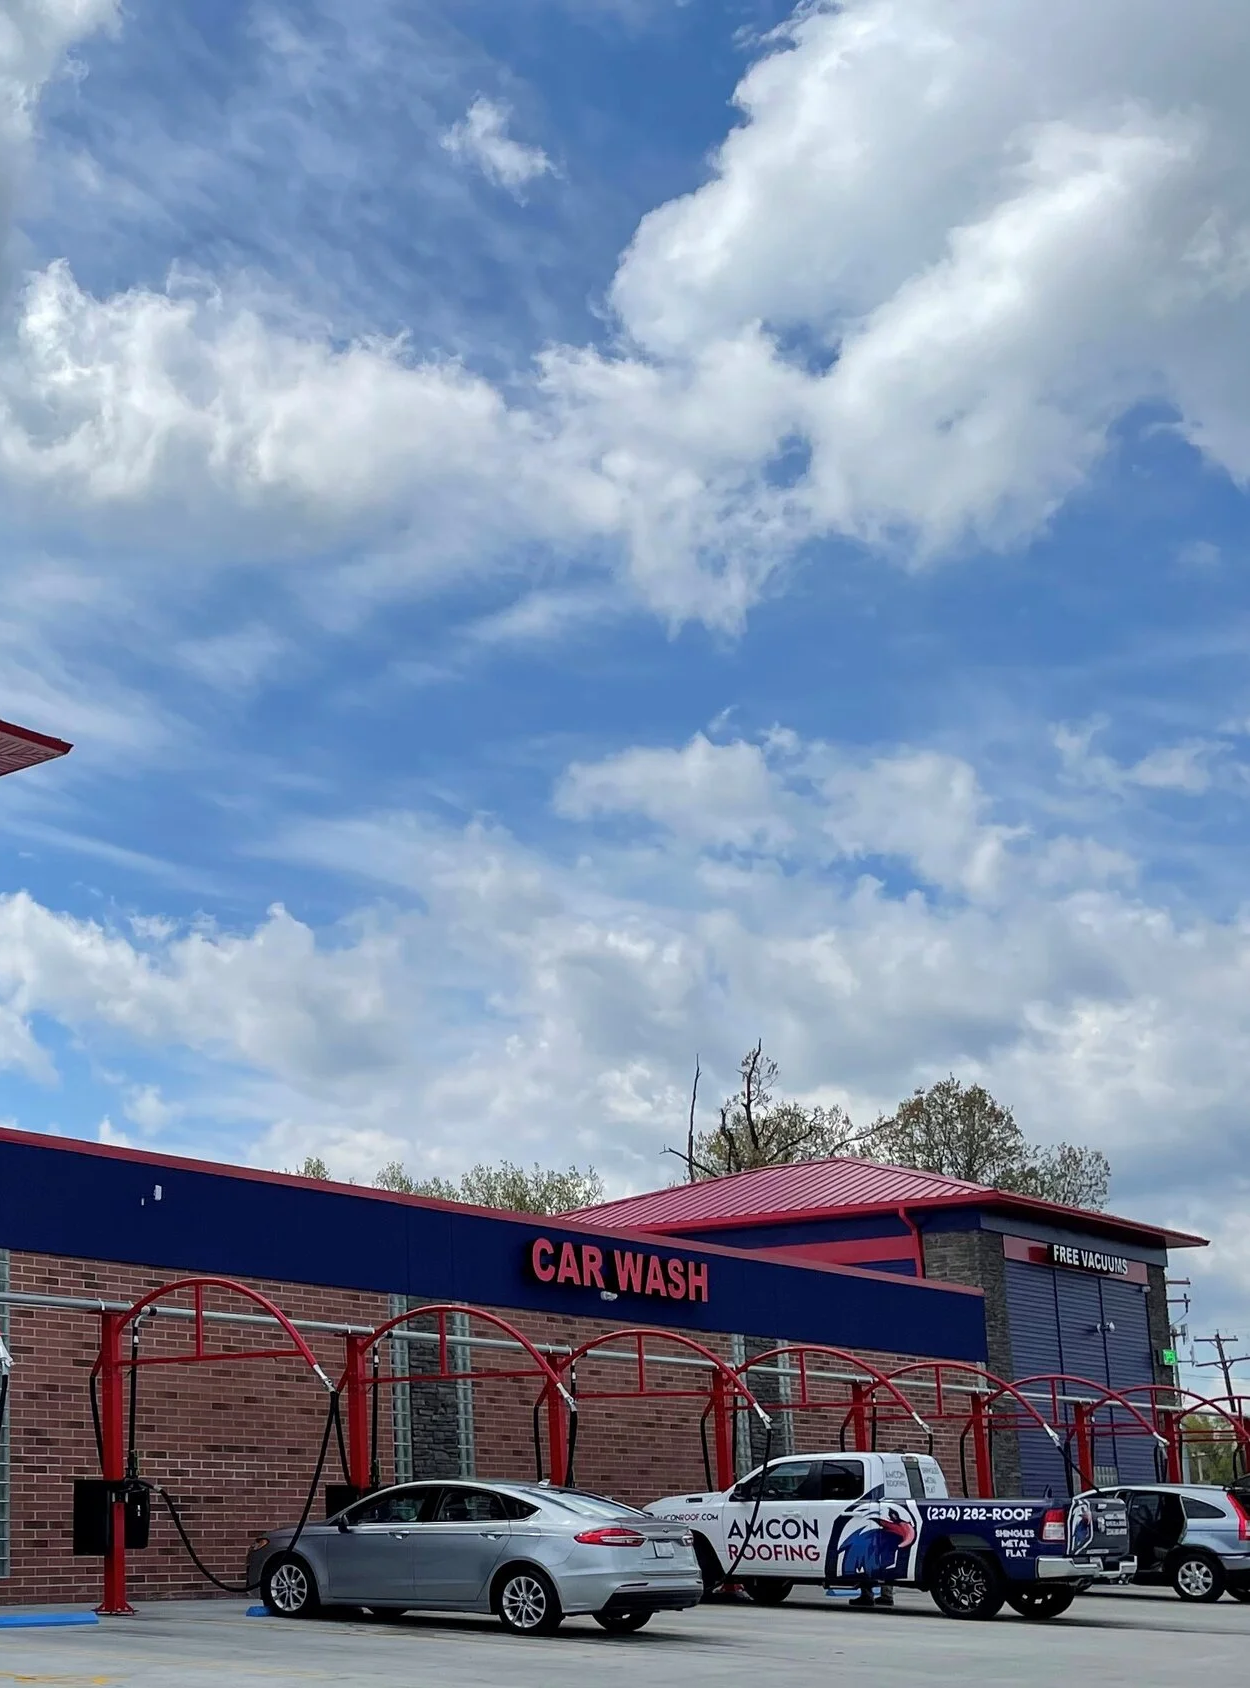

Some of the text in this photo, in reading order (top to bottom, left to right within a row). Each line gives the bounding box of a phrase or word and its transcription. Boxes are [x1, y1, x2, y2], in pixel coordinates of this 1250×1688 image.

[1053, 1244, 1129, 1275] FREE VACUUMS
[532, 1237, 709, 1302] CAR WASH
[926, 1506, 1033, 1521] (234) 282-ROOF
[727, 1518, 820, 1540] AMCON
[994, 1529, 1035, 1538] SHINGLES
[1001, 1540, 1031, 1548] METAL
[727, 1544, 821, 1562] ROOFING
[1005, 1549, 1028, 1558] FLAT
